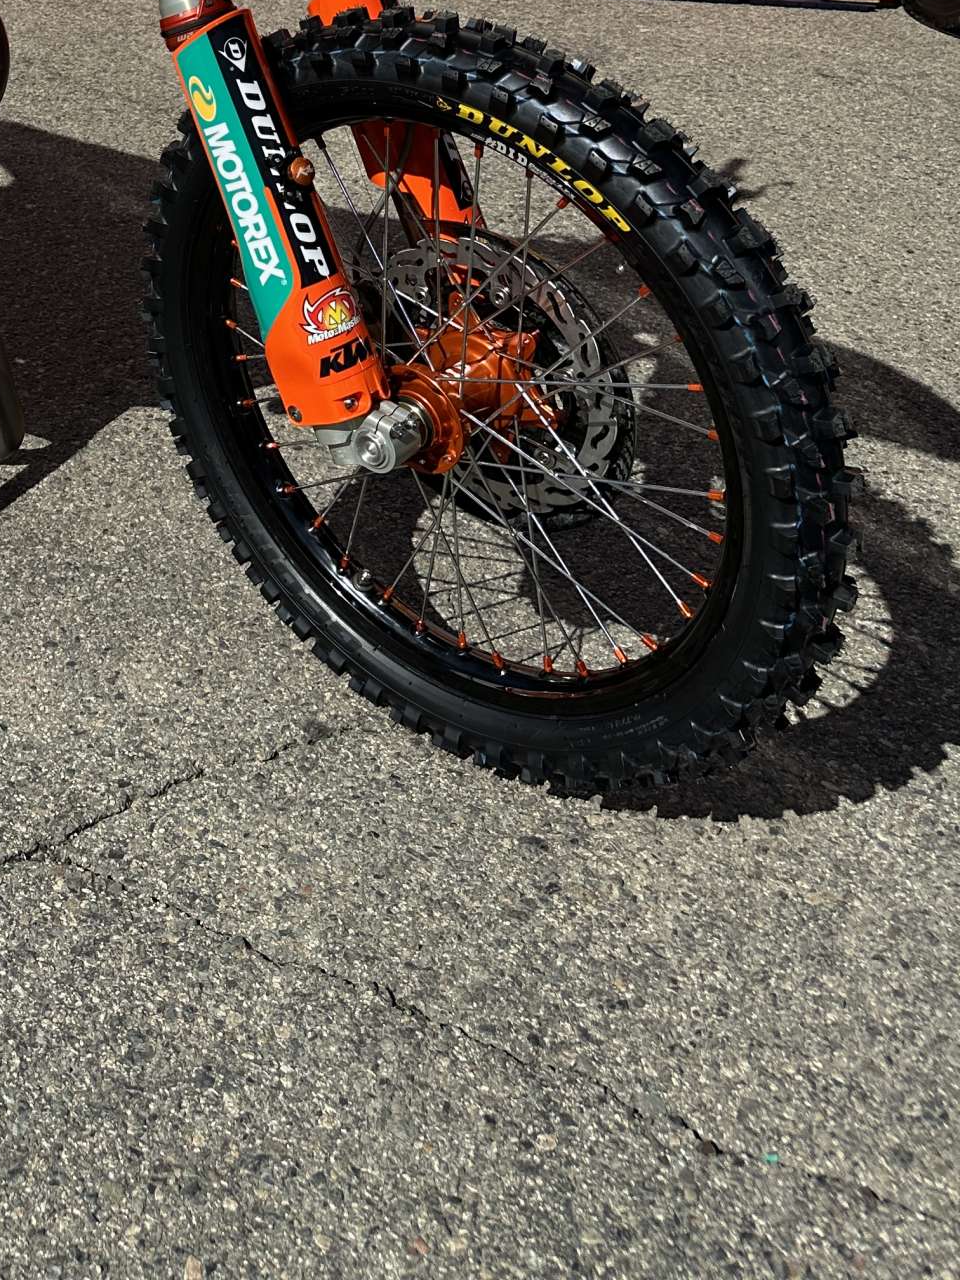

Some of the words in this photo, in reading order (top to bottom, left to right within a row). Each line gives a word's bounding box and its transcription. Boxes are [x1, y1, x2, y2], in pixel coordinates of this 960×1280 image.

[203, 121, 286, 287] MOTOREX
[236, 78, 330, 278] DUOP
[455, 103, 631, 233] DUNLOP
[494, 142, 528, 167] DID
